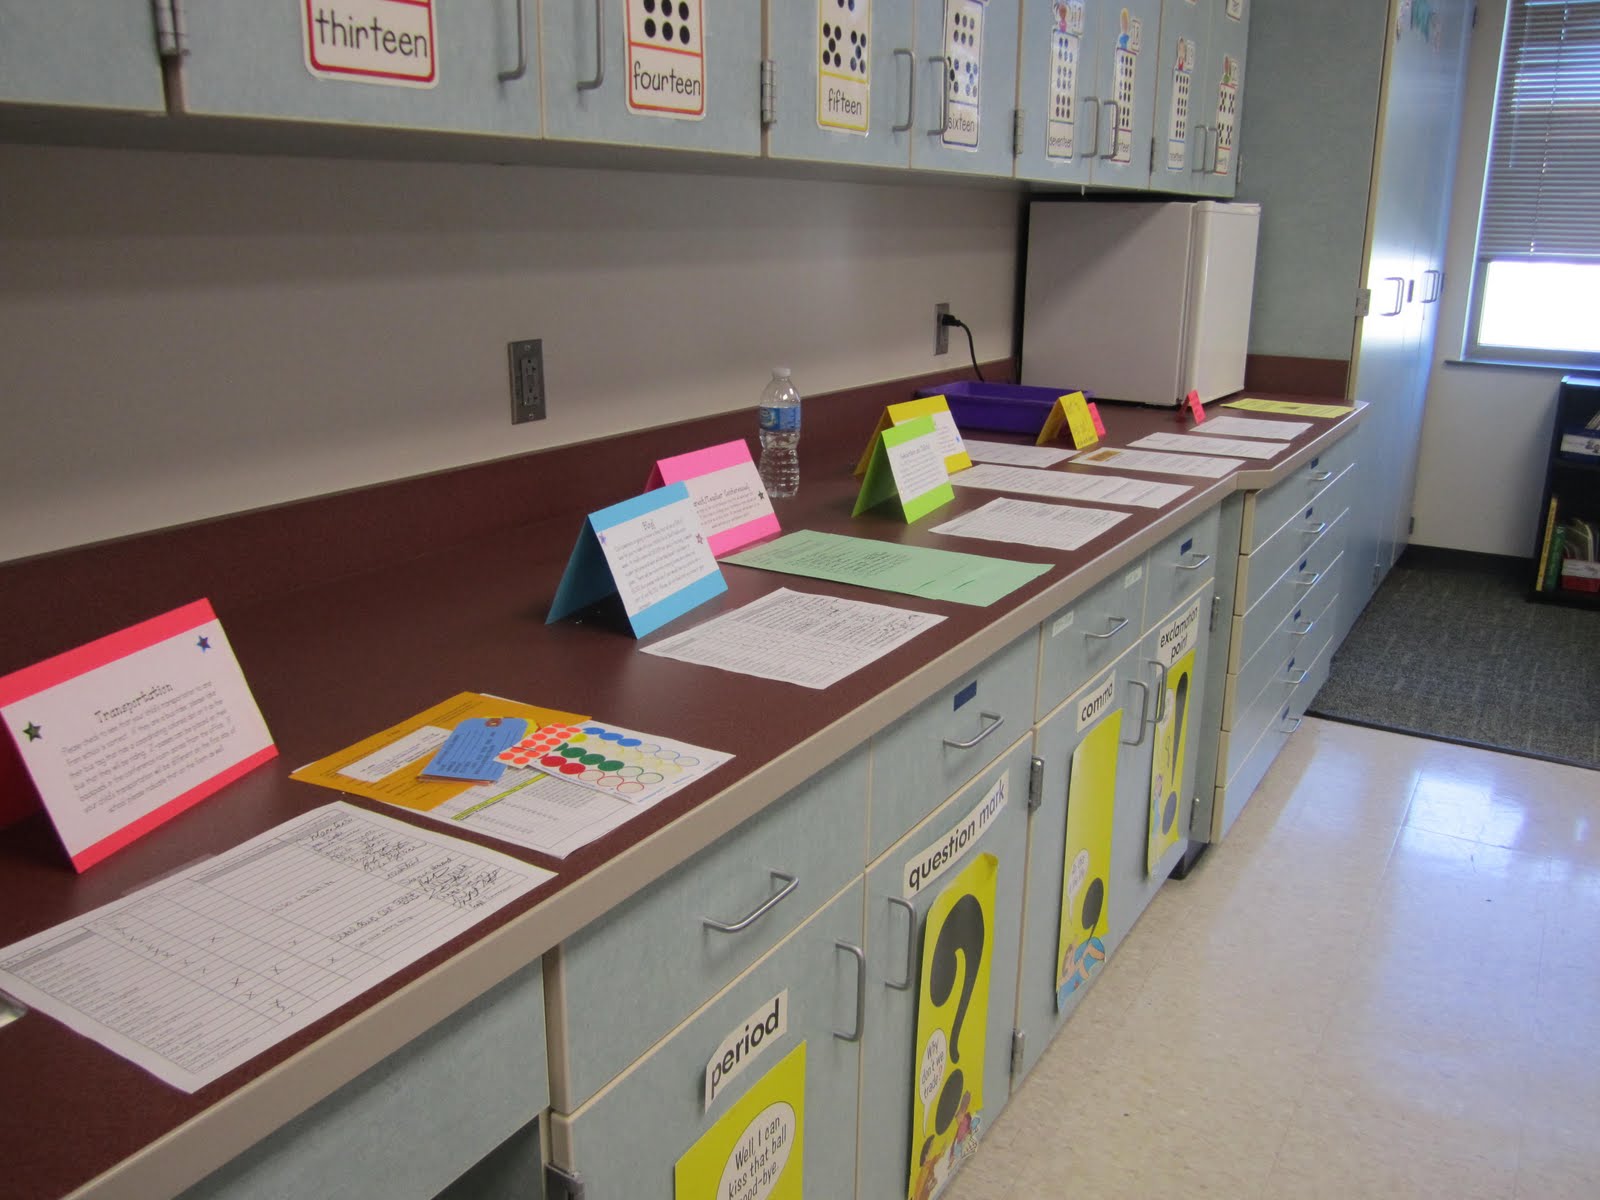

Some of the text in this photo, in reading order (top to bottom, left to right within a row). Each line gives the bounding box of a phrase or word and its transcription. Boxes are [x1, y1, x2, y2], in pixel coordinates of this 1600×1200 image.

[315, 9, 428, 58] thirteen
[633, 60, 701, 96] fourteen
[827, 88, 863, 116] fifteen
[948, 113, 975, 133] sixteen
[1160, 606, 1198, 648] exclamation
[1171, 633, 1188, 664] point
[94, 682, 174, 724] Transportation
[1081, 683, 1113, 722] comma
[908, 779, 1005, 892] question mark
[711, 998, 780, 1100] period
[758, 1129, 761, 1147] I
[765, 1117, 780, 1141] can
[728, 1124, 787, 1200] kiss that ball
